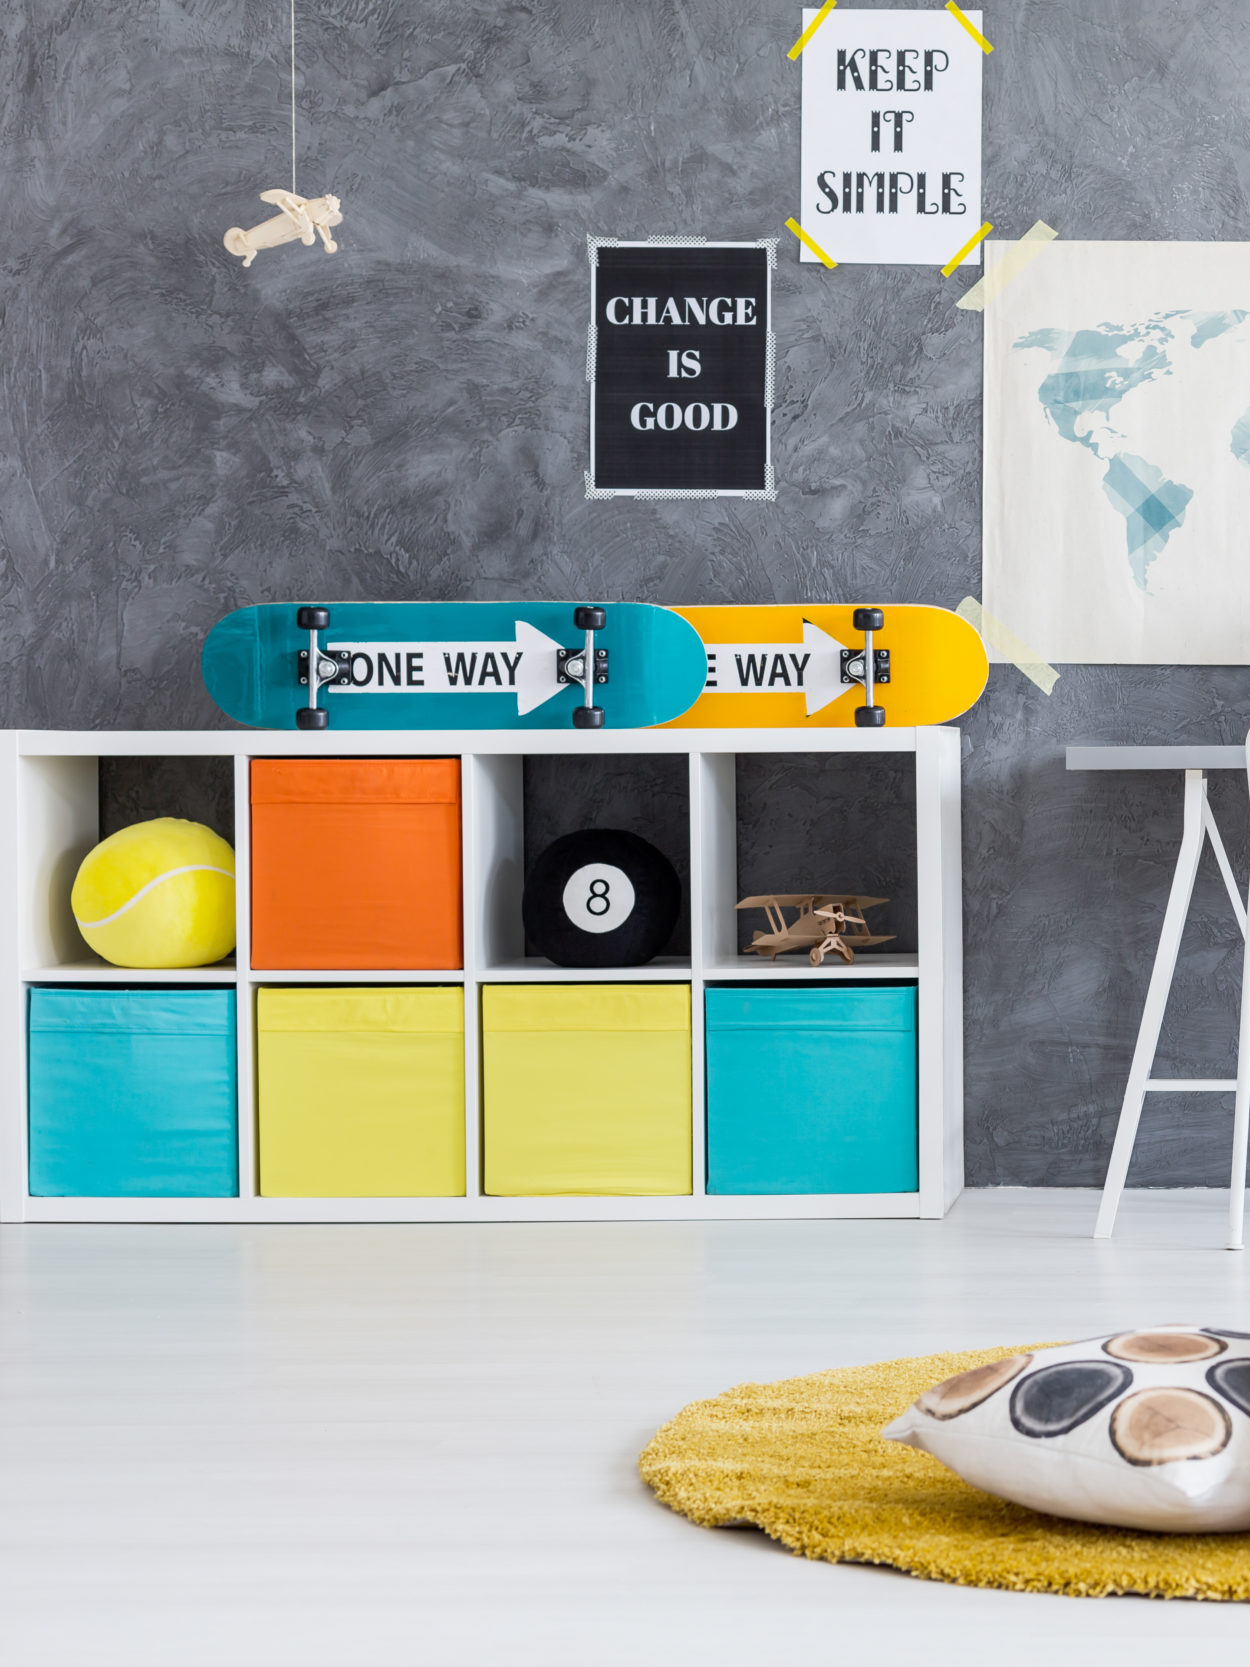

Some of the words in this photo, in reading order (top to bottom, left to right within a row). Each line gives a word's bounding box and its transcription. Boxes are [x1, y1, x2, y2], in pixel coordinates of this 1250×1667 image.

[836, 48, 950, 92] KEEP
[870, 109, 915, 153] IT
[815, 170, 967, 215] SIMPLE
[605, 296, 757, 326] CHANGE
[666, 350, 702, 379] IS
[630, 402, 738, 432] GOOD
[350, 652, 425, 687] ONE
[443, 652, 524, 686] WAY
[734, 653, 812, 687] WAY
[585, 878, 611, 916] 8
